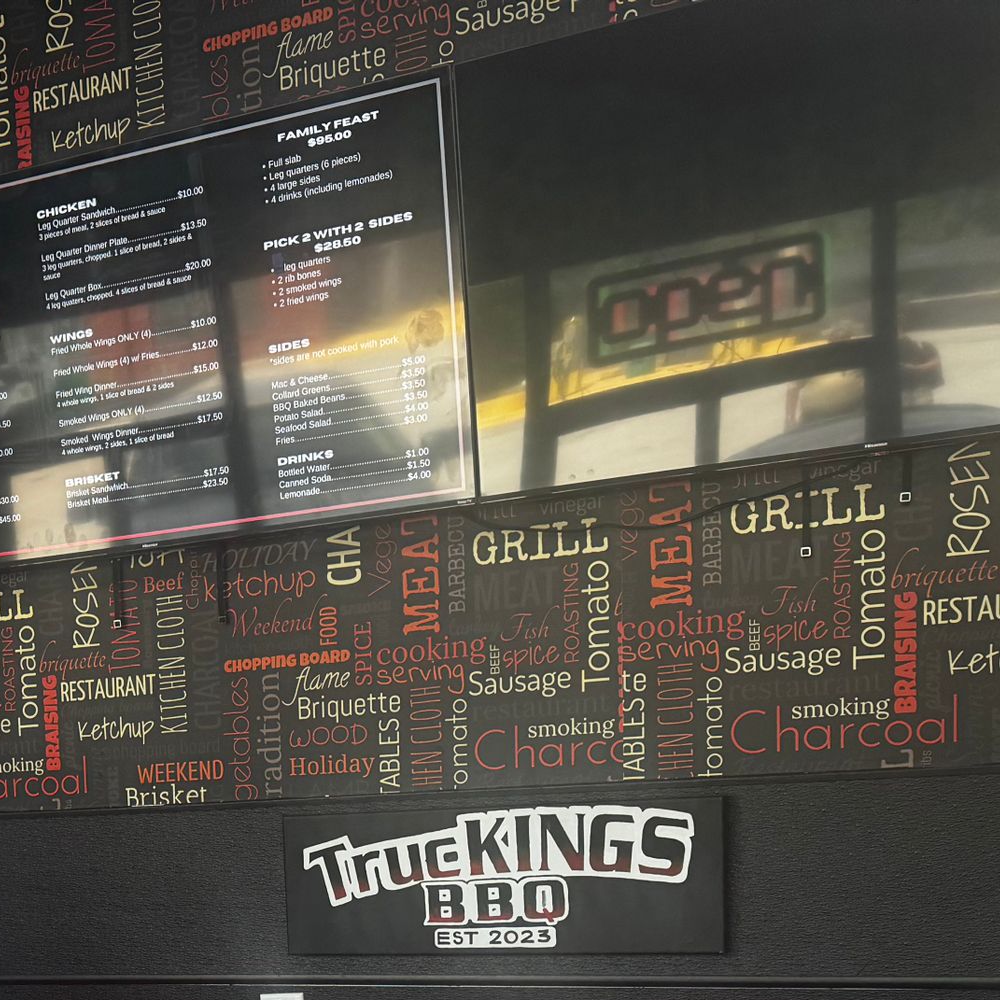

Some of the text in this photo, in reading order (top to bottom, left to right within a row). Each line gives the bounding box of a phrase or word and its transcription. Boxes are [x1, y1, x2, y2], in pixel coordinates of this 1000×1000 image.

[203, 8, 334, 52] CHOPPING BOARD
[361, 3, 450, 39] serving
[32, 66, 133, 113] RESTAURANT
[51, 116, 131, 153] Ketchup
[277, 110, 379, 142] FAMILY FEAST
[307, 128, 352, 147] $95.00
[268, 153, 301, 168] Full slab
[269, 169, 284, 181] Leg
[285, 162, 319, 178] quarters
[331, 151, 361, 168] pieces)
[278, 189, 302, 202] drinks
[304, 180, 342, 199] (including
[344, 168, 393, 190] lemonades)
[36, 197, 97, 219] CHICKEN
[37, 221, 51, 232] Leg
[52, 214, 79, 228] Quarter
[177, 185, 203, 199] $10.00
[263, 234, 299, 251] PICK
[313, 223, 352, 240] WITH
[368, 210, 413, 229] SIDES
[285, 281, 317, 295] smoked
[318, 277, 342, 290] wings
[49, 328, 92, 344] WINGS
[268, 337, 310, 353] SIDES
[58, 415, 86, 427] Smoked
[88, 411, 110, 423] Wings
[111, 407, 131, 418] ONLY
[196, 391, 222, 403] $12.50
[272, 401, 291, 413] BBQ
[293, 397, 318, 408] Baked
[274, 421, 307, 434] Seafood
[277, 449, 334, 466] DRINKS
[278, 466, 305, 478] Bottled
[405, 447, 428, 458] $1.00
[65, 471, 120, 487] BRISKET
[278, 476, 309, 489] Canned
[406, 458, 430, 470] $1.50
[407, 469, 431, 481] $4.00
[67, 498, 90, 508] Brisket
[202, 477, 228, 488] $23.50
[472, 517, 609, 566] GRILL
[144, 573, 184, 594] Beef
[852, 529, 886, 670] Tomato
[227, 593, 328, 641] Weekend
[319, 606, 337, 646] FOOD
[156, 594, 187, 734] KITCHEN CLOTH
[224, 649, 350, 673] CHOPPING BOARD
[353, 621, 373, 687] SPICE
[377, 635, 487, 665] cooking
[490, 644, 500, 674] BEEF
[724, 647, 841, 676] Sausage
[893, 591, 917, 715] BRAISING
[15, 625, 39, 736] Tomato
[60, 674, 156, 702] RESTAURANT
[281, 666, 350, 706] flame
[298, 692, 401, 723] Briquette
[791, 697, 891, 720] smoking
[78, 717, 155, 745] Ketchup
[697, 676, 723, 777] tomato
[730, 693, 959, 754] Charcoal
[137, 759, 225, 784] WEEKEND
[289, 753, 375, 778] Holiday
[423, 876, 569, 926] BBQ
[437, 929, 551, 945] EST 2023
